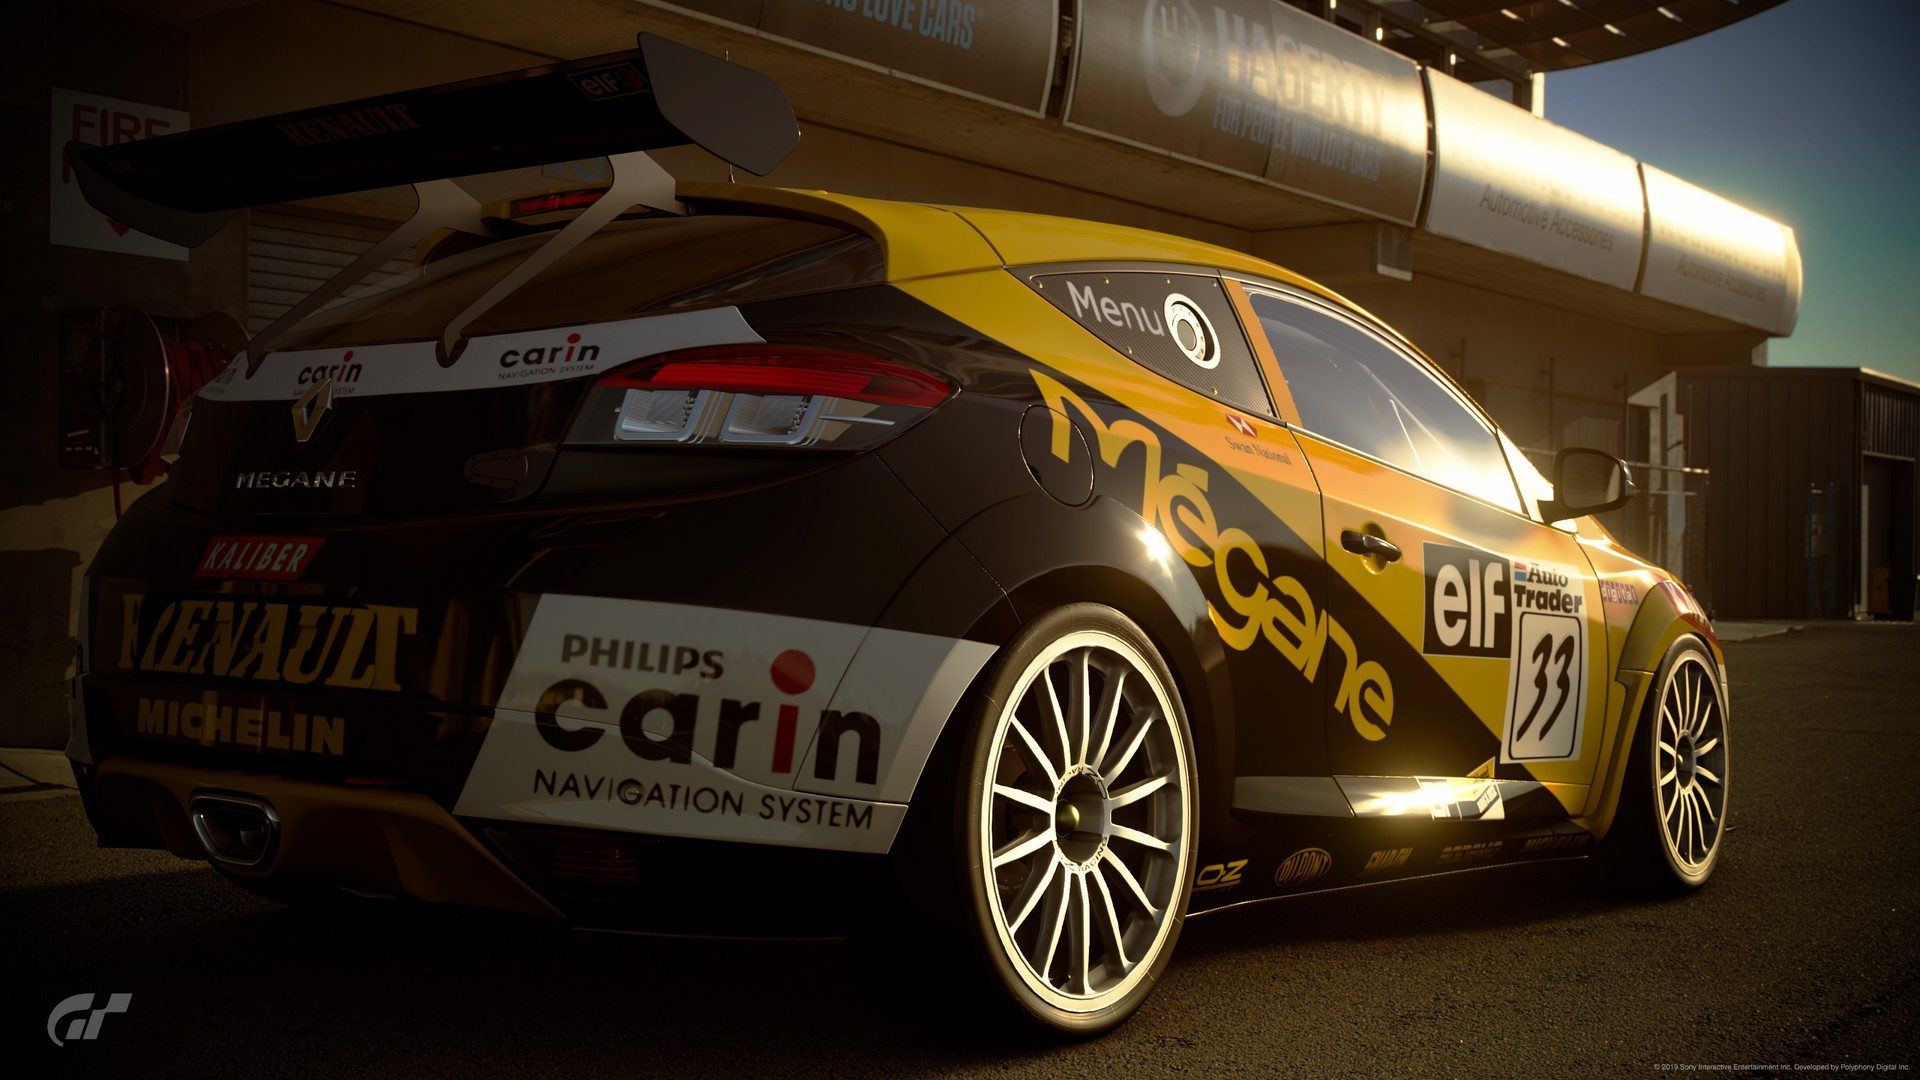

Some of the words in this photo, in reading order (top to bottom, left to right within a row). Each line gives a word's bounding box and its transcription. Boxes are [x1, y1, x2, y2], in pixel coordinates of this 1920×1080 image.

[918, 0, 974, 49] CARS
[579, 72, 617, 96] elf
[279, 102, 422, 148] RENAULT
[1212, 95, 1240, 134] FOR
[1243, 102, 1290, 153] PEOPLE
[1291, 117, 1321, 162] WHO
[1321, 127, 1350, 171] LOVE
[1350, 140, 1382, 182] CARS
[1479, 183, 1549, 229] Automotive
[1549, 206, 1613, 252] Accessories
[1067, 281, 1164, 337] Menu
[298, 351, 362, 385] carin
[498, 366, 556, 380] NAVIGATION
[559, 364, 595, 374] SYSTEM
[500, 333, 600, 368] carin
[1224, 436, 1253, 456] Swan
[1254, 442, 1293, 465] National
[235, 470, 358, 489] MEGANE
[203, 541, 309, 573] KALIBER
[1526, 565, 1569, 588] Auto
[1433, 559, 1505, 648] elf
[1514, 585, 1583, 613] Trader
[117, 594, 419, 693] RENAULT
[561, 634, 725, 681] PHILIPS
[1516, 633, 1575, 742] 33
[137, 697, 345, 757] MICHELIN
[535, 649, 882, 786] carin
[534, 769, 744, 815] NAVIGATION
[759, 794, 873, 830] SYSTEM
[1197, 859, 1249, 886] OZ
